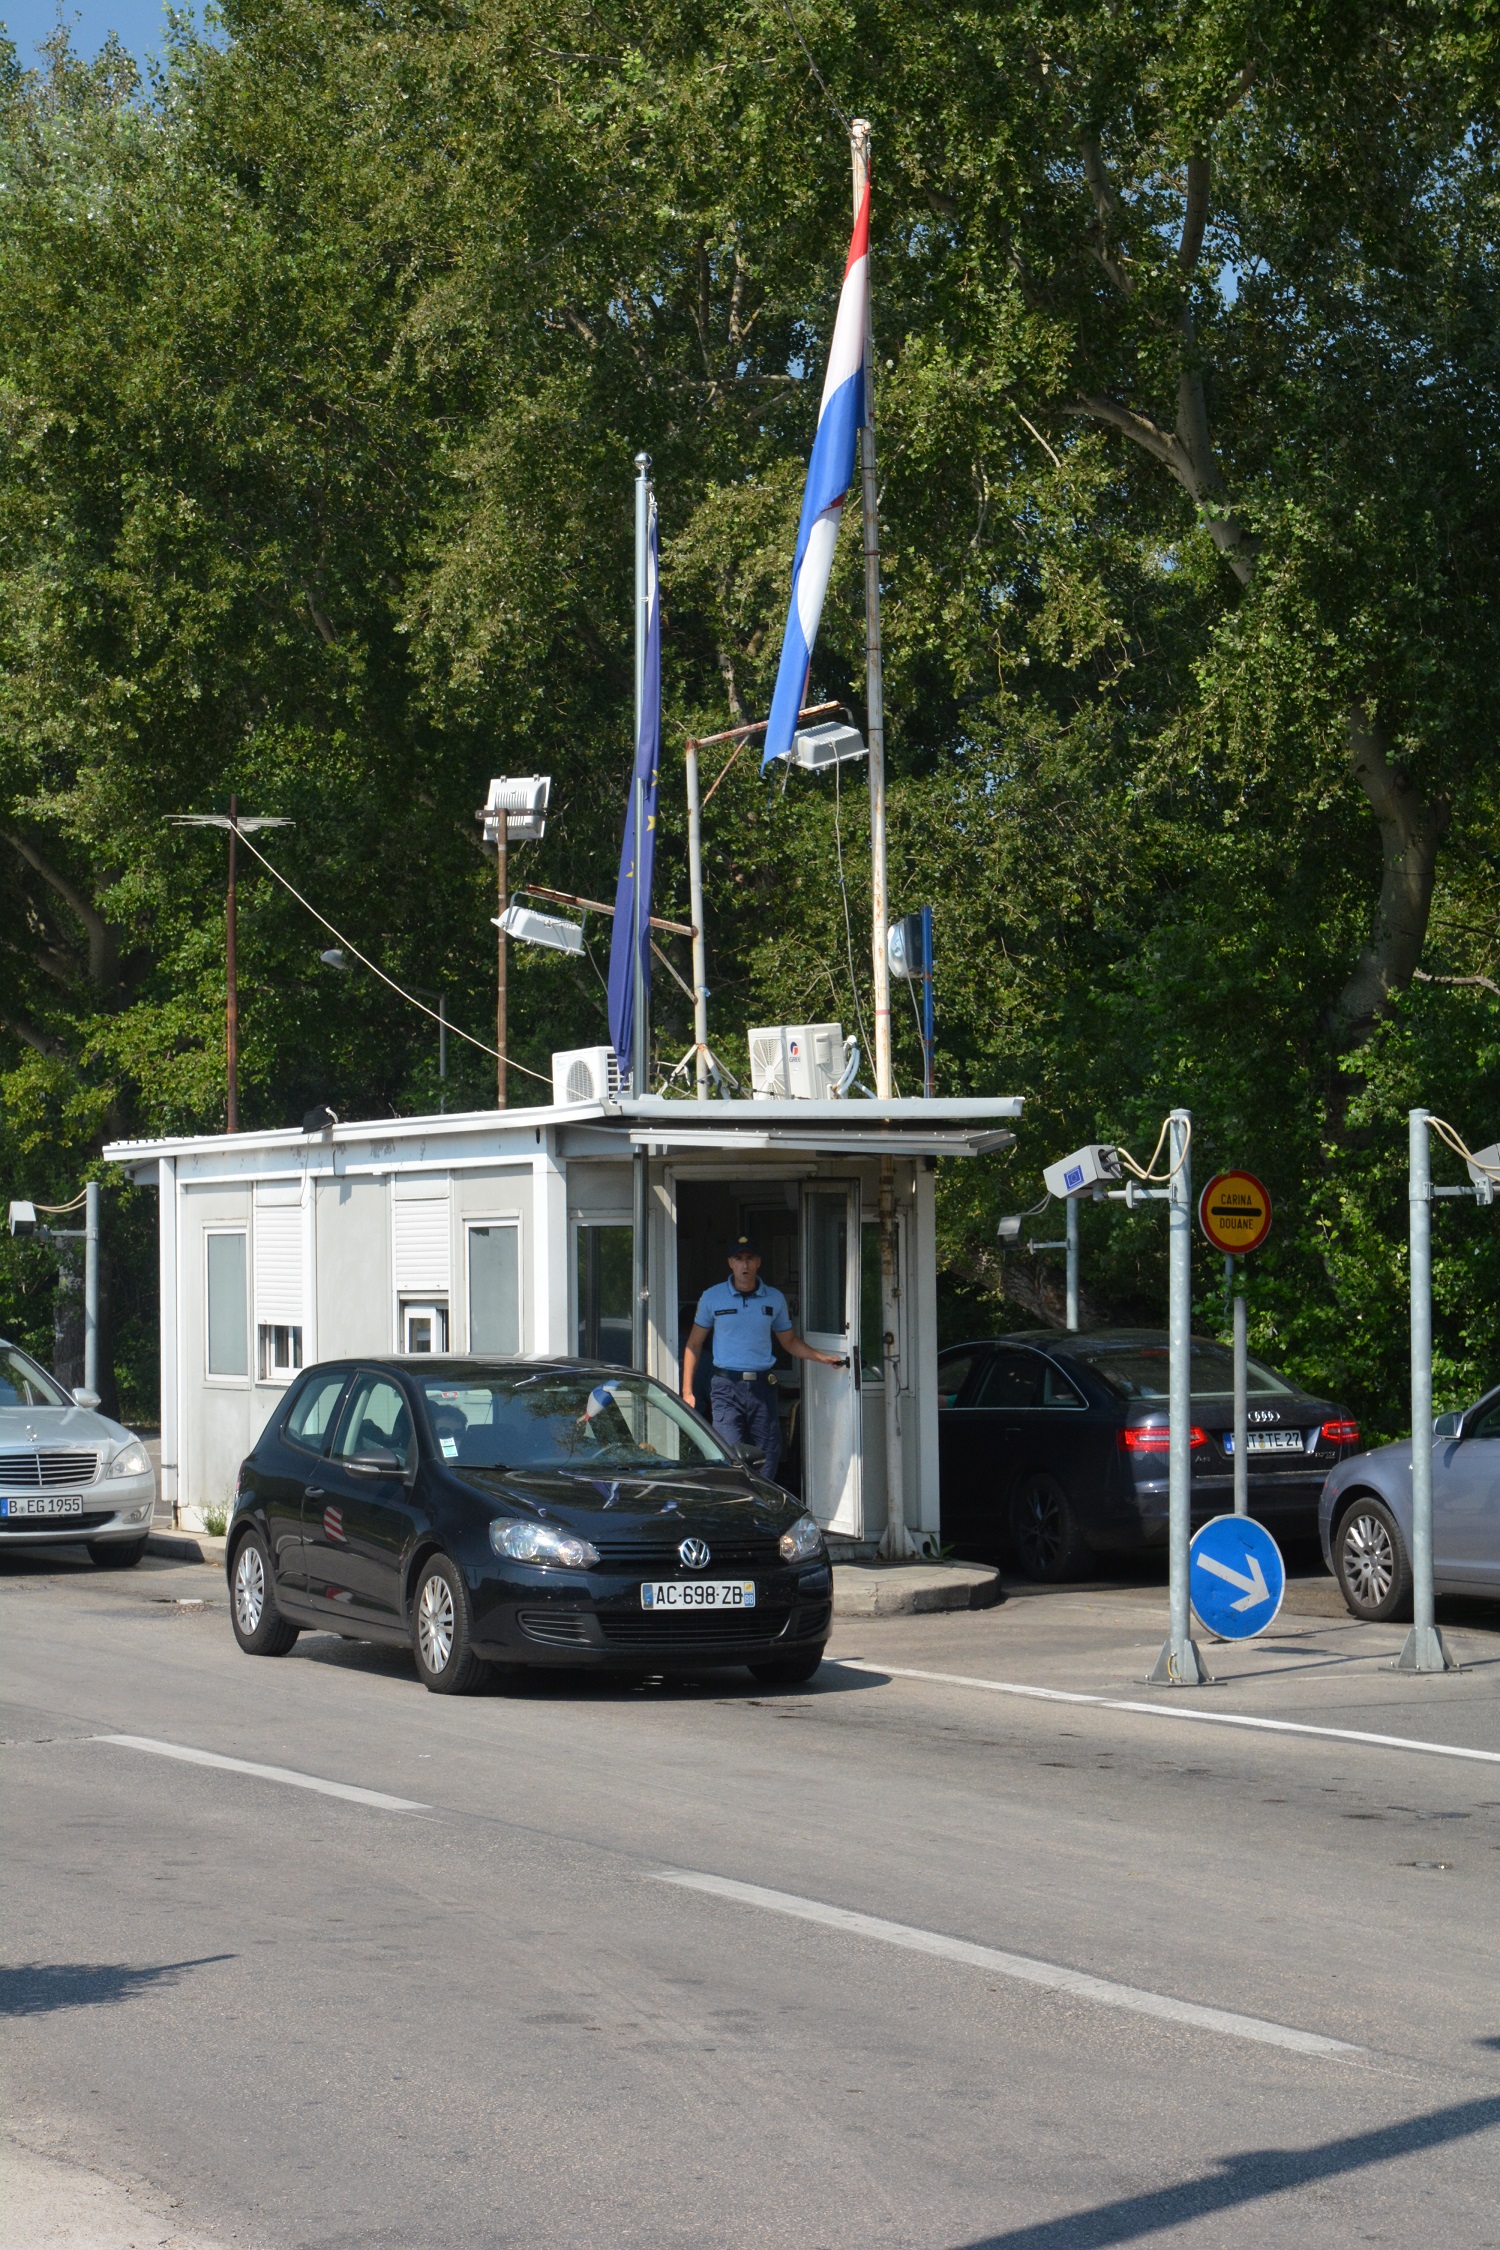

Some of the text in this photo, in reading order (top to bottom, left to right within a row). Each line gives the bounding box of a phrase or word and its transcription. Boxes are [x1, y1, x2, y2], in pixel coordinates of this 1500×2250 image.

[1221, 1194, 1252, 1205] CARINA
[1220, 1218, 1253, 1229] DOUANE
[1265, 1433, 1283, 1447] TE
[1285, 1432, 1299, 1447] 27
[9, 1501, 17, 1514] B
[27, 1500, 45, 1513] EG
[48, 1498, 80, 1513] 1955
[745, 1594, 753, 1604] 88
